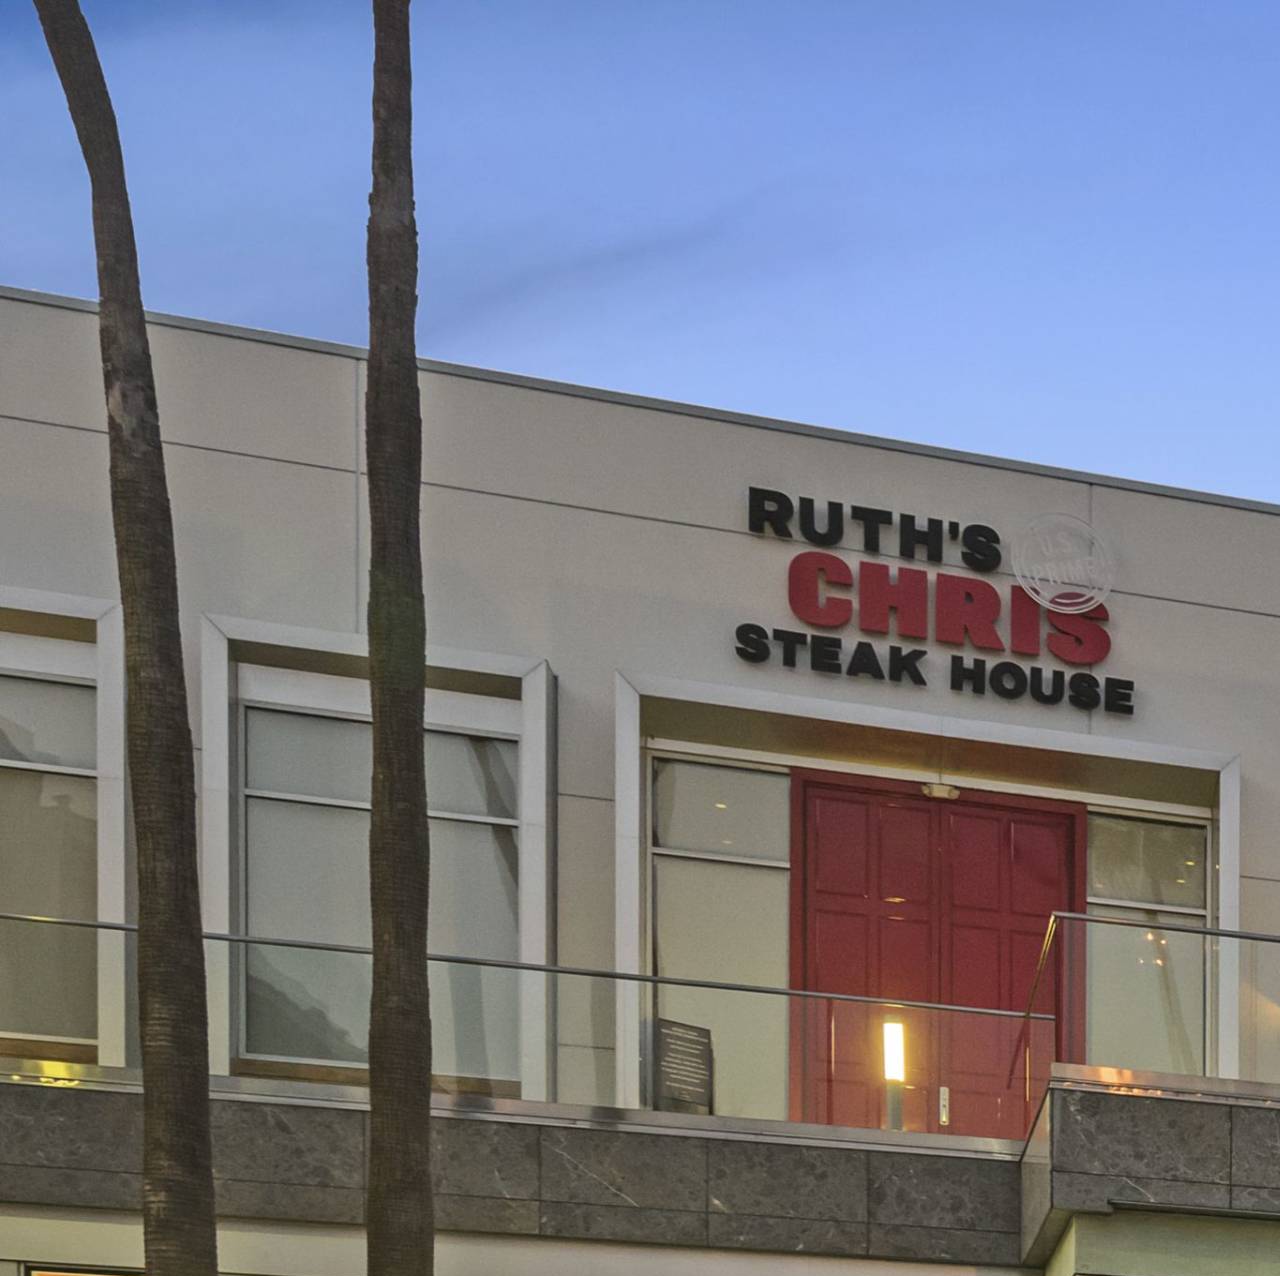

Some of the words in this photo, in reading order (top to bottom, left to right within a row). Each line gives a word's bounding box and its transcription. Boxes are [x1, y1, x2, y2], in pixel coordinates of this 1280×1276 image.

[748, 486, 1002, 572] RUTH'S
[788, 551, 1111, 665] CHRIS
[735, 623, 927, 686] STEAK
[950, 655, 1135, 716] HOUSE
